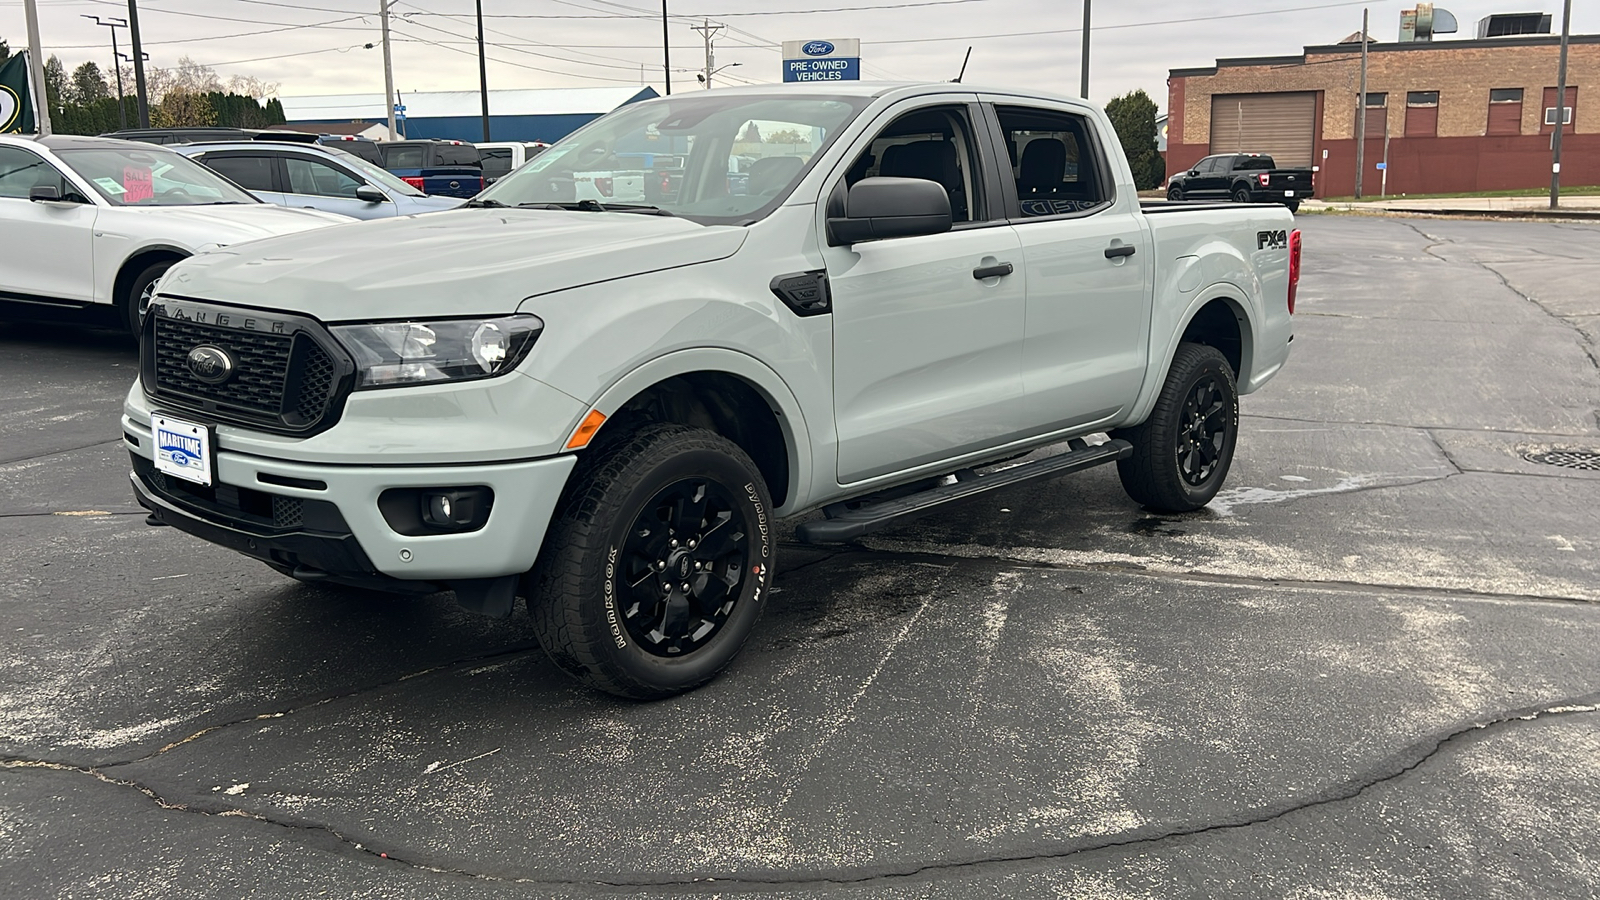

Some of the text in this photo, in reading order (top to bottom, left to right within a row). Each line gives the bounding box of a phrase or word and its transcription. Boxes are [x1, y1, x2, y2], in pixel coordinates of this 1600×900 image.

[808, 43, 827, 53] Ford
[790, 60, 848, 71] PRE-OWNED
[796, 71, 841, 81] VEHICLES
[125, 171, 149, 182] SALE
[1257, 230, 1287, 250] FX4
[191, 352, 216, 374] Ford
[160, 431, 201, 458] MARITIME
